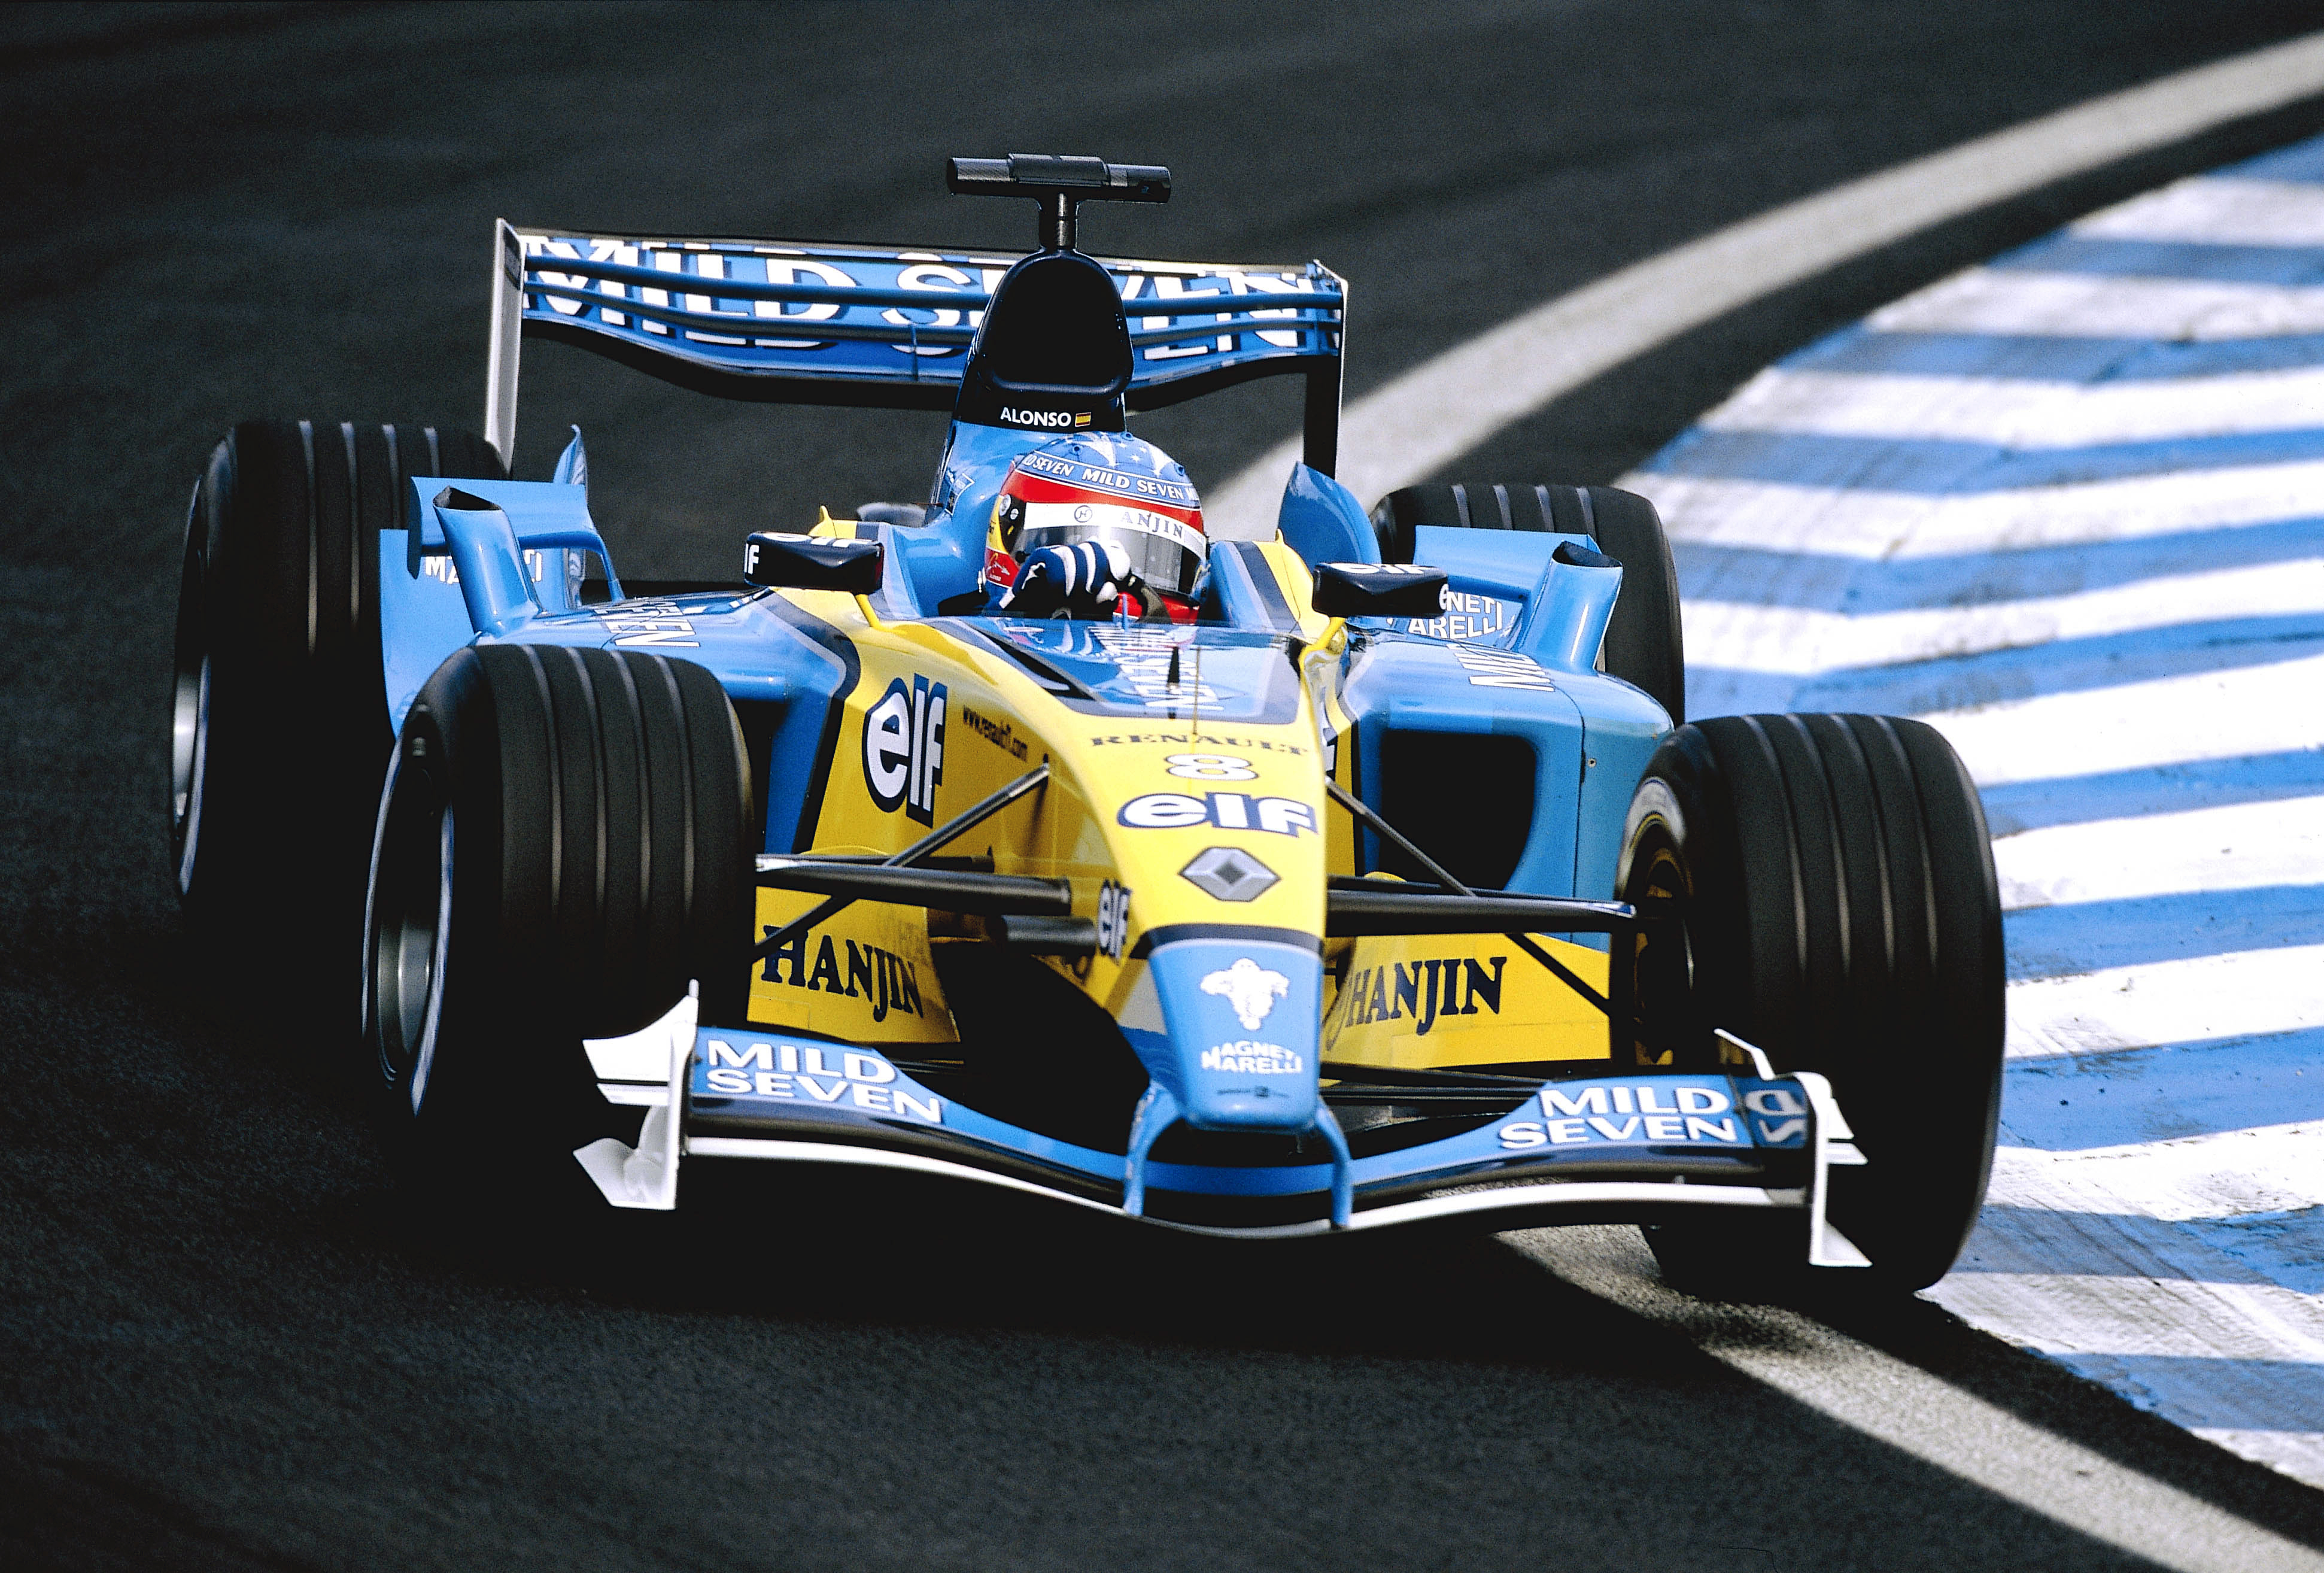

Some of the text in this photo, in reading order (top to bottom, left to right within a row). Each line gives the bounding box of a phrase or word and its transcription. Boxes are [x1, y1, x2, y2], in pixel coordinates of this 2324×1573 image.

[879, 251, 1313, 360] SEN
[1000, 407, 1071, 427] ALONSO
[1033, 456, 1074, 477] SEVEN
[1082, 468, 1131, 489] MILD
[1137, 480, 1184, 500] SEVEN
[1121, 511, 1183, 539] ANJIN
[744, 543, 760, 575] lf
[862, 673, 947, 828] elf
[1091, 734, 1308, 756] RENAULT
[1164, 754, 1259, 781] 8
[1117, 791, 1318, 837] elf
[1098, 879, 1131, 962] elf
[761, 924, 923, 1022] HANJIN
[1345, 956, 1507, 1037] HANJIN
[707, 1040, 896, 1084] MILD
[707, 1068, 943, 1123] SEVEN
[1538, 1086, 1730, 1118] MILD
[1499, 1117, 1738, 1150] SEVEN
